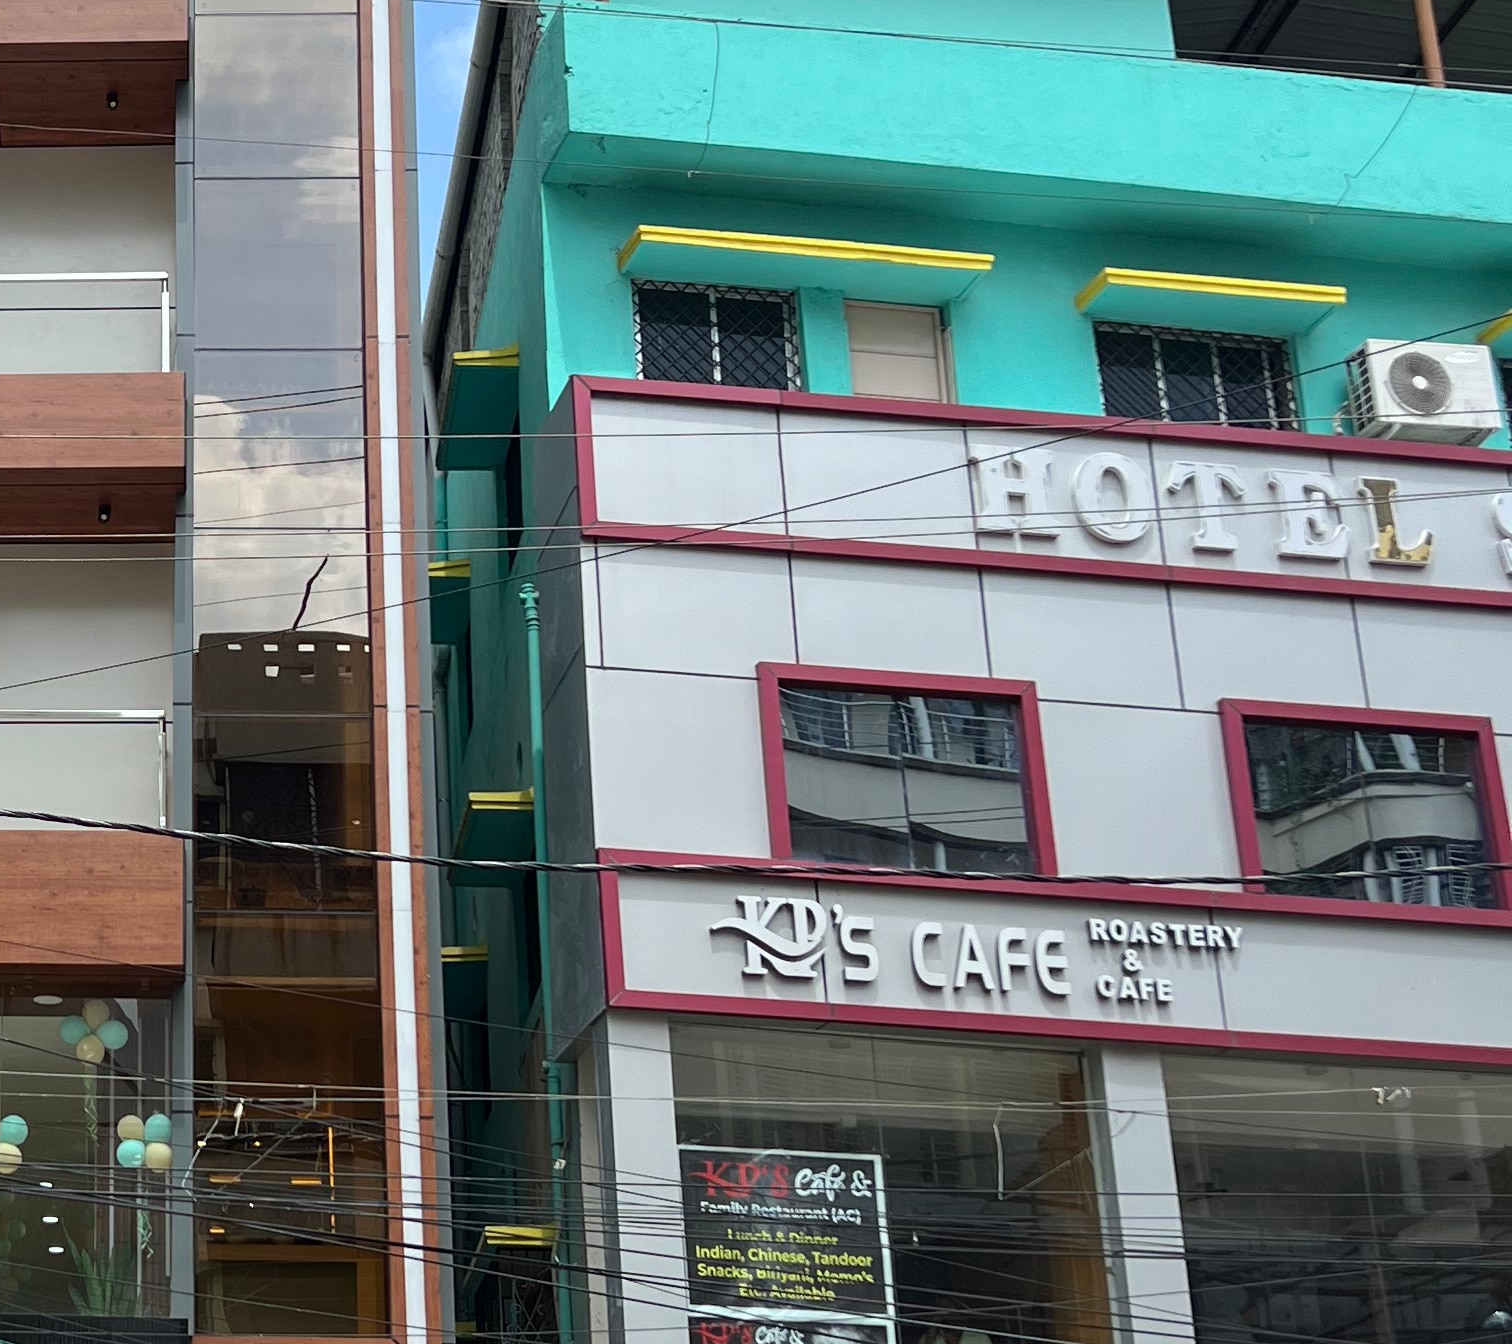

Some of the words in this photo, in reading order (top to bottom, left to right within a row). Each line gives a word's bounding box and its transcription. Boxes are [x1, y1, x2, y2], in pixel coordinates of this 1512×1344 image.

[968, 444, 1435, 567] HOTEL
[1089, 917, 1243, 951] ROASTERY
[912, 921, 1072, 997] CAFE
[1123, 949, 1144, 972] &
[1098, 974, 1174, 1004] CAFE
[850, 1169, 873, 1198] &
[700, 1201, 748, 1218] Family
[751, 1203, 830, 1222] Restaurant
[832, 1208, 862, 1226] (AC)
[695, 1244, 745, 1263] Indian,
[747, 1248, 810, 1267] Chinese,
[811, 1251, 873, 1268] Tandoor
[697, 1263, 753, 1281] Snacks,
